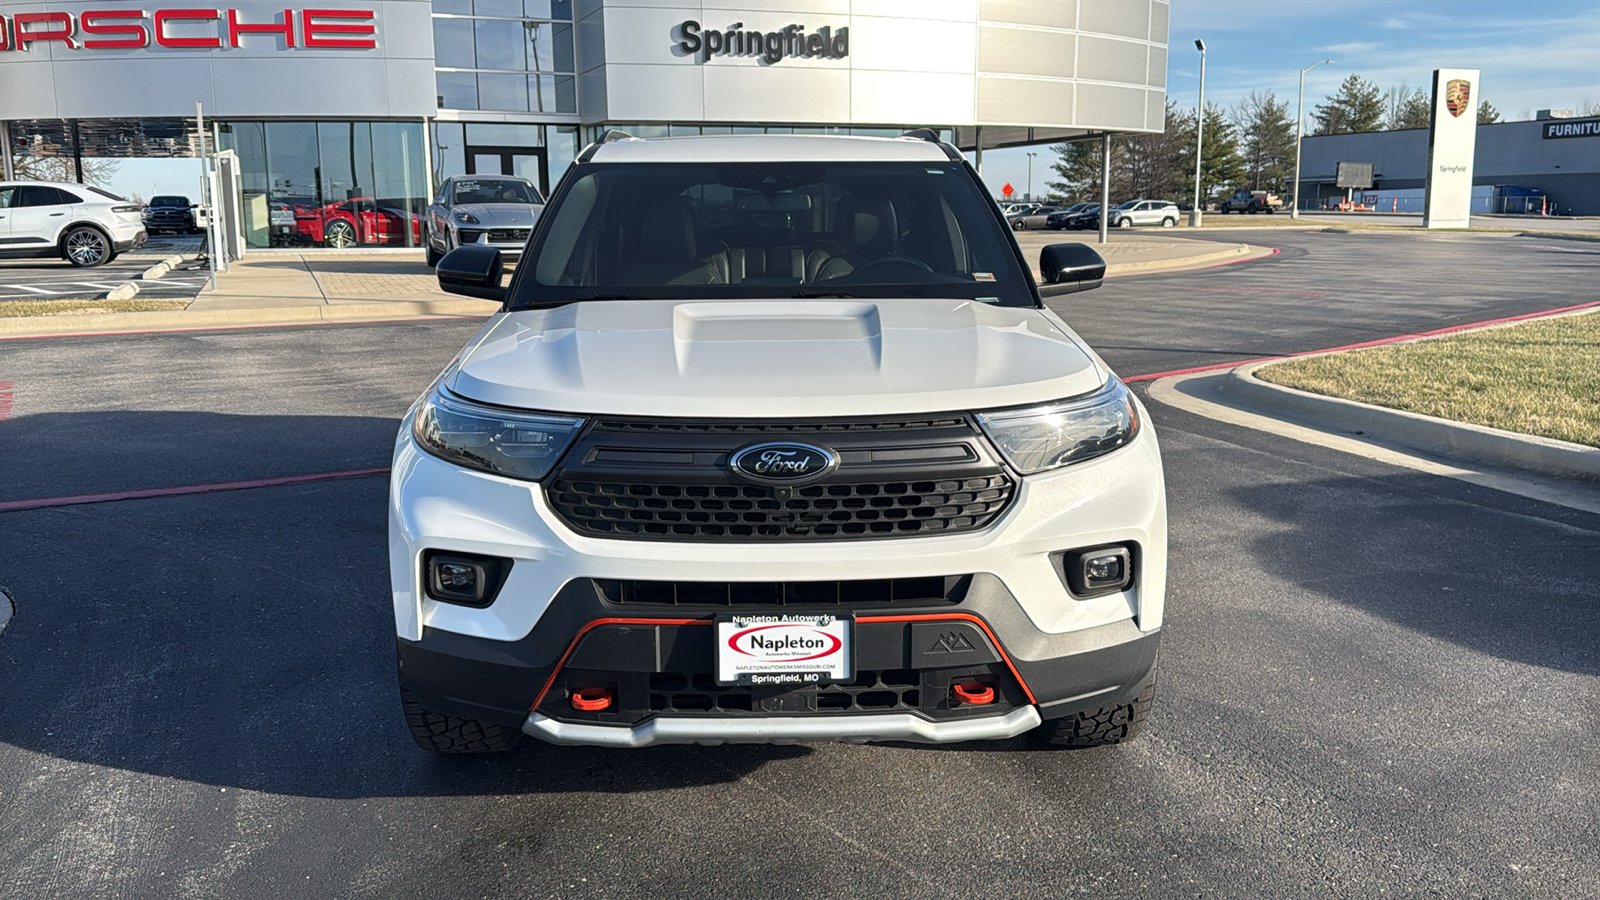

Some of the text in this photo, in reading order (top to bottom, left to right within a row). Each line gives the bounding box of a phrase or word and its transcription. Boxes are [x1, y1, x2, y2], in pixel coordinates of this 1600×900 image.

[0, 9, 376, 51] RSCHE
[680, 20, 849, 63] Springfield
[1439, 165, 1466, 173] Springfield
[755, 450, 811, 473] Ford
[732, 614, 836, 623] Napleton Autowerks
[751, 635, 824, 652] Napleton
[751, 674, 819, 684] Springfield, MO
